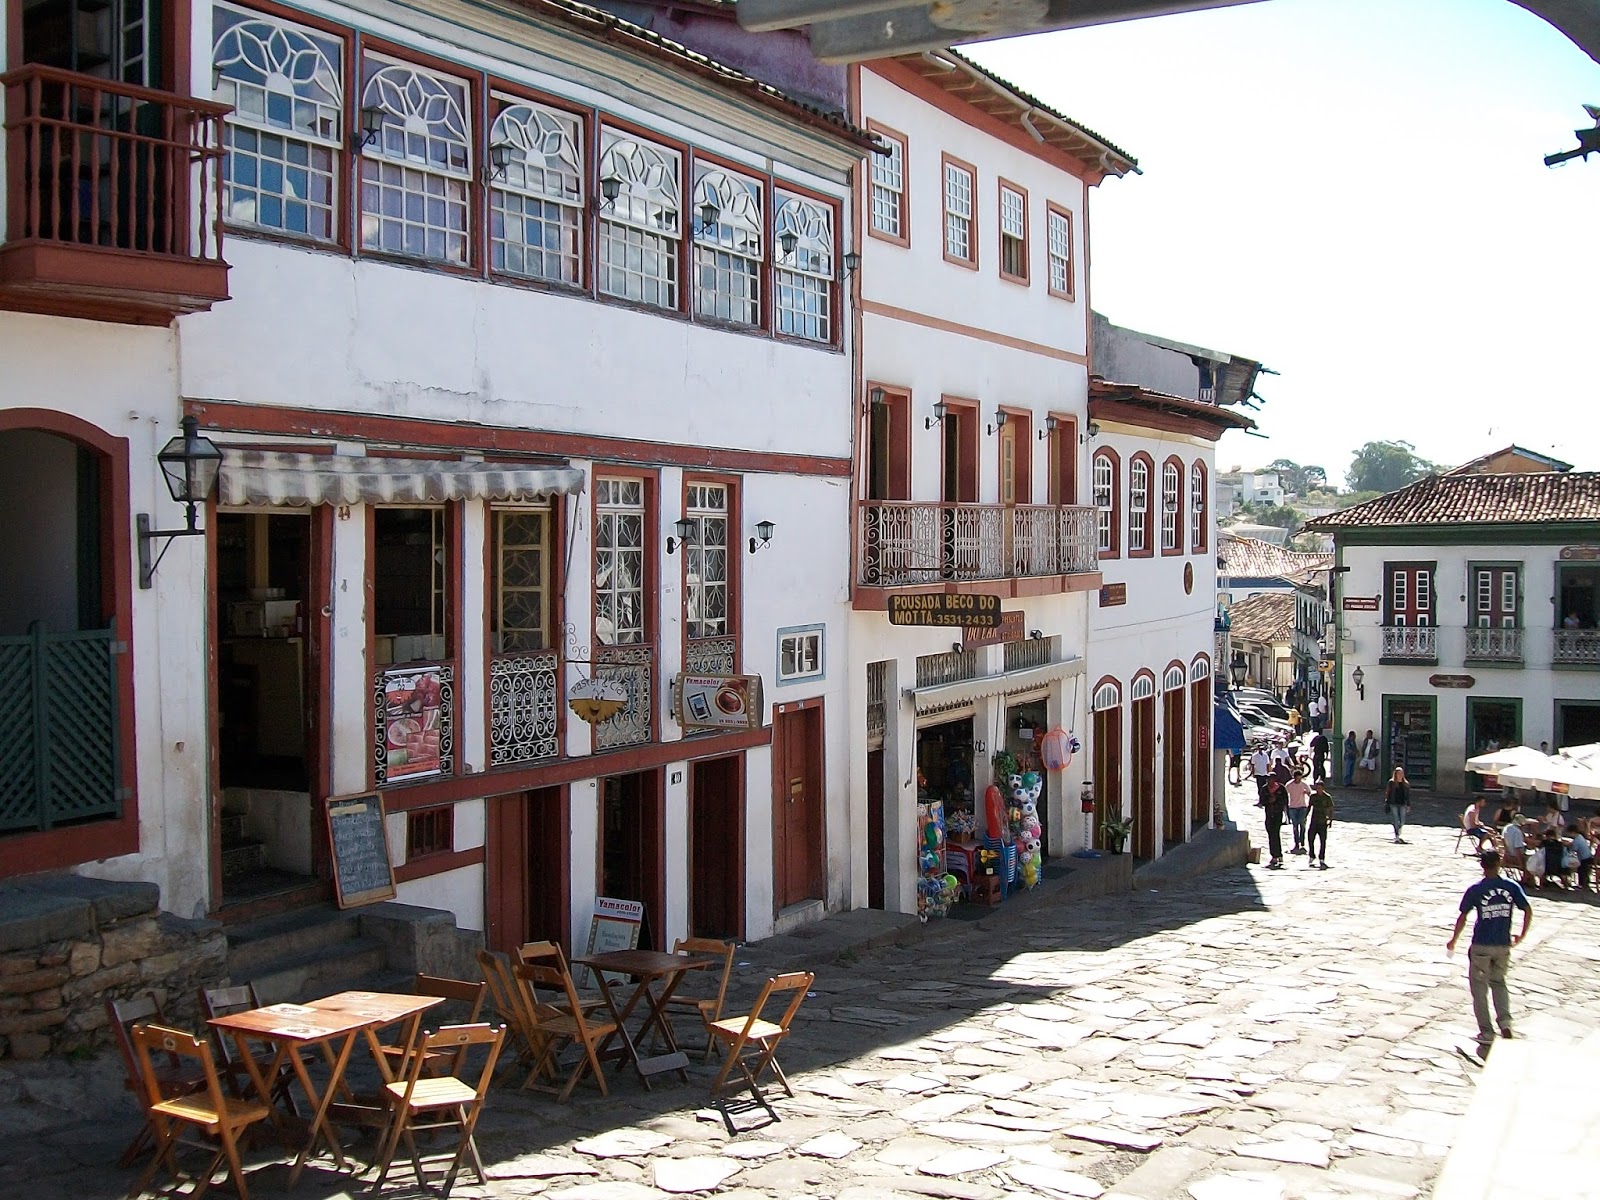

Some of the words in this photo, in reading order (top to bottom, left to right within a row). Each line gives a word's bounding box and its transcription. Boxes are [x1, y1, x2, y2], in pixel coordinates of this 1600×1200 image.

[894, 595, 941, 610] POUSADA
[945, 594, 974, 609] BECO
[980, 595, 995, 610] DO
[686, 678, 720, 686] Yamacolor
[1481, 888, 1513, 906] ELETRO
[599, 900, 641, 912] Yamacolor
